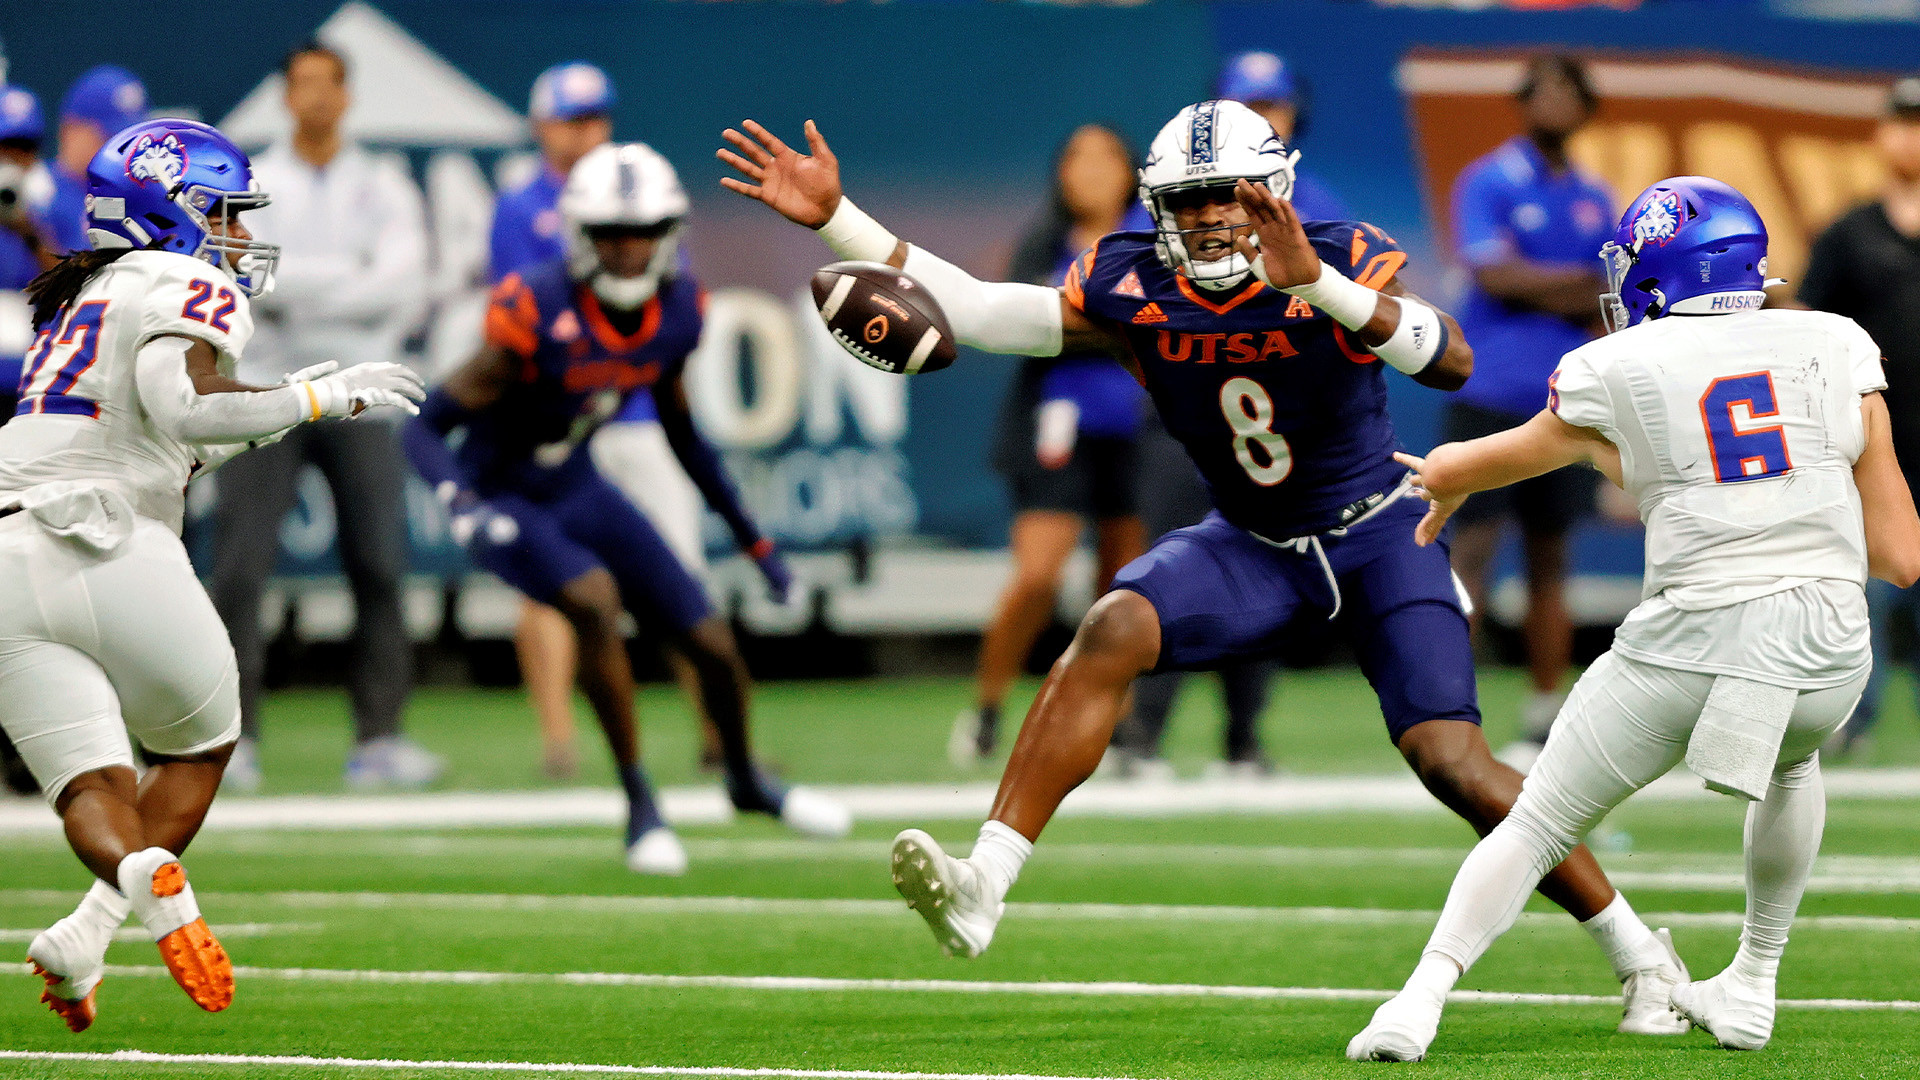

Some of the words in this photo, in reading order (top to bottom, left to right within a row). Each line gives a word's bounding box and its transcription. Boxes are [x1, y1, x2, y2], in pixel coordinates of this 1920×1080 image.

[1185, 164, 1217, 175] UTSA
[181, 277, 238, 334] 22
[1157, 329, 1299, 364] UTSA
[1219, 375, 1293, 487] 8
[1698, 369, 1793, 484] 6
